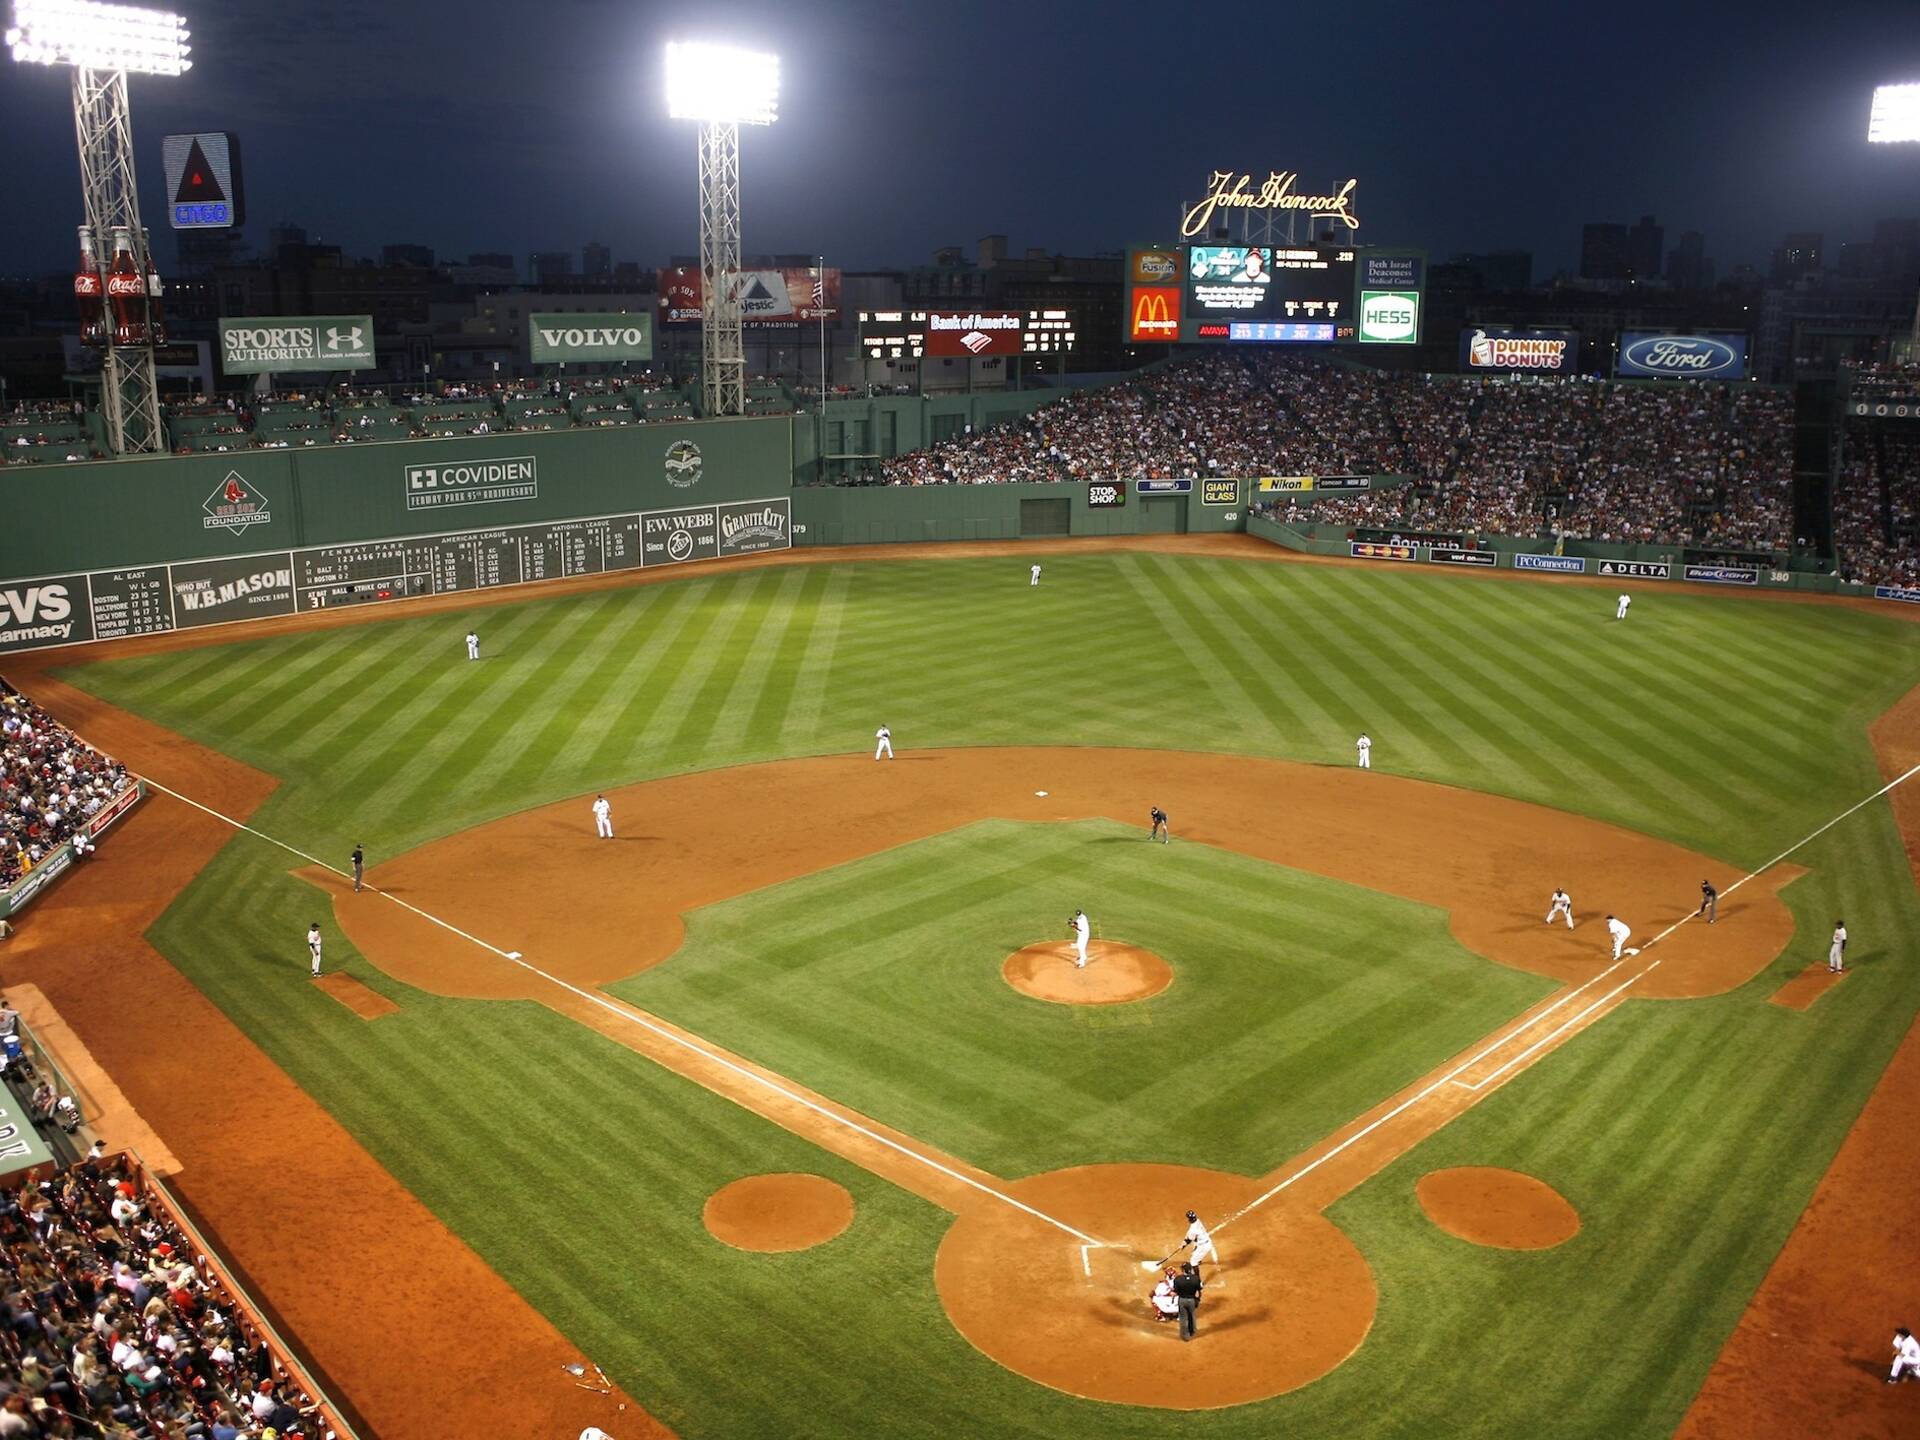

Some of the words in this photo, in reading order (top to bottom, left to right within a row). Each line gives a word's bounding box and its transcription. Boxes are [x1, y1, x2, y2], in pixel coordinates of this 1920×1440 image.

[1182, 170, 1255, 237] John
[1254, 171, 1360, 229] Hancock
[176, 203, 228, 224] CITGO
[1369, 260, 1387, 268] Beth
[1390, 260, 1412, 268] Israel
[1369, 268, 1412, 277] Deaconess
[931, 314, 961, 330] Bank
[961, 314, 974, 329] of
[974, 314, 1020, 329] America
[1367, 310, 1411, 324] HESS
[1200, 326, 1229, 335] AVAYA
[225, 328, 313, 349] SPORTS
[540, 328, 642, 347] VOLVO
[1496, 340, 1566, 354] DUNKIN'
[227, 348, 314, 362] AUTHORITY
[1646, 341, 1719, 368] Ford
[1495, 354, 1563, 367] DONUTS
[442, 462, 532, 486] COVIDIEN
[1206, 483, 1235, 492] GIANT
[1271, 479, 1302, 490] Nikon
[1090, 486, 1115, 496] STOP
[1205, 492, 1235, 501] GLASS
[1090, 495, 1115, 504] SHOP
[207, 514, 268, 526] FOUNDATION
[673, 513, 714, 529] WEBB
[763, 507, 786, 531] CITY
[1224, 512, 1238, 520] 420
[552, 523, 583, 531] NATIONAL
[585, 520, 610, 528] LEAGUE
[792, 525, 806, 533] 379
[441, 535, 477, 544] AMERICAN
[480, 531, 507, 539] LEAGUE
[321, 547, 367, 557] FENWAY
[375, 543, 404, 551] PARK
[646, 543, 664, 552] Since
[1520, 556, 1533, 566] PC
[1533, 556, 1581, 570] Connection
[317, 566, 332, 574] BALT
[1618, 563, 1667, 576] DELTA
[1689, 569, 1713, 577] BUD
[1719, 570, 1752, 579] LIGHT
[314, 574, 337, 583] BOSTON
[1771, 571, 1789, 582] 380
[175, 582, 194, 593] WHO
[196, 581, 211, 590] BUT
[332, 587, 347, 595] BALL
[354, 584, 375, 592] STRIKE
[93, 595, 119, 604] BOSTON
[248, 595, 272, 603] SINCE
[311, 597, 325, 608] 31
[95, 602, 128, 613] BALTIMORE
[111, 611, 127, 619] YORK
[97, 621, 117, 629] TAMPA
[0, 623, 72, 642] armacy
[98, 628, 127, 637] TORONTO
